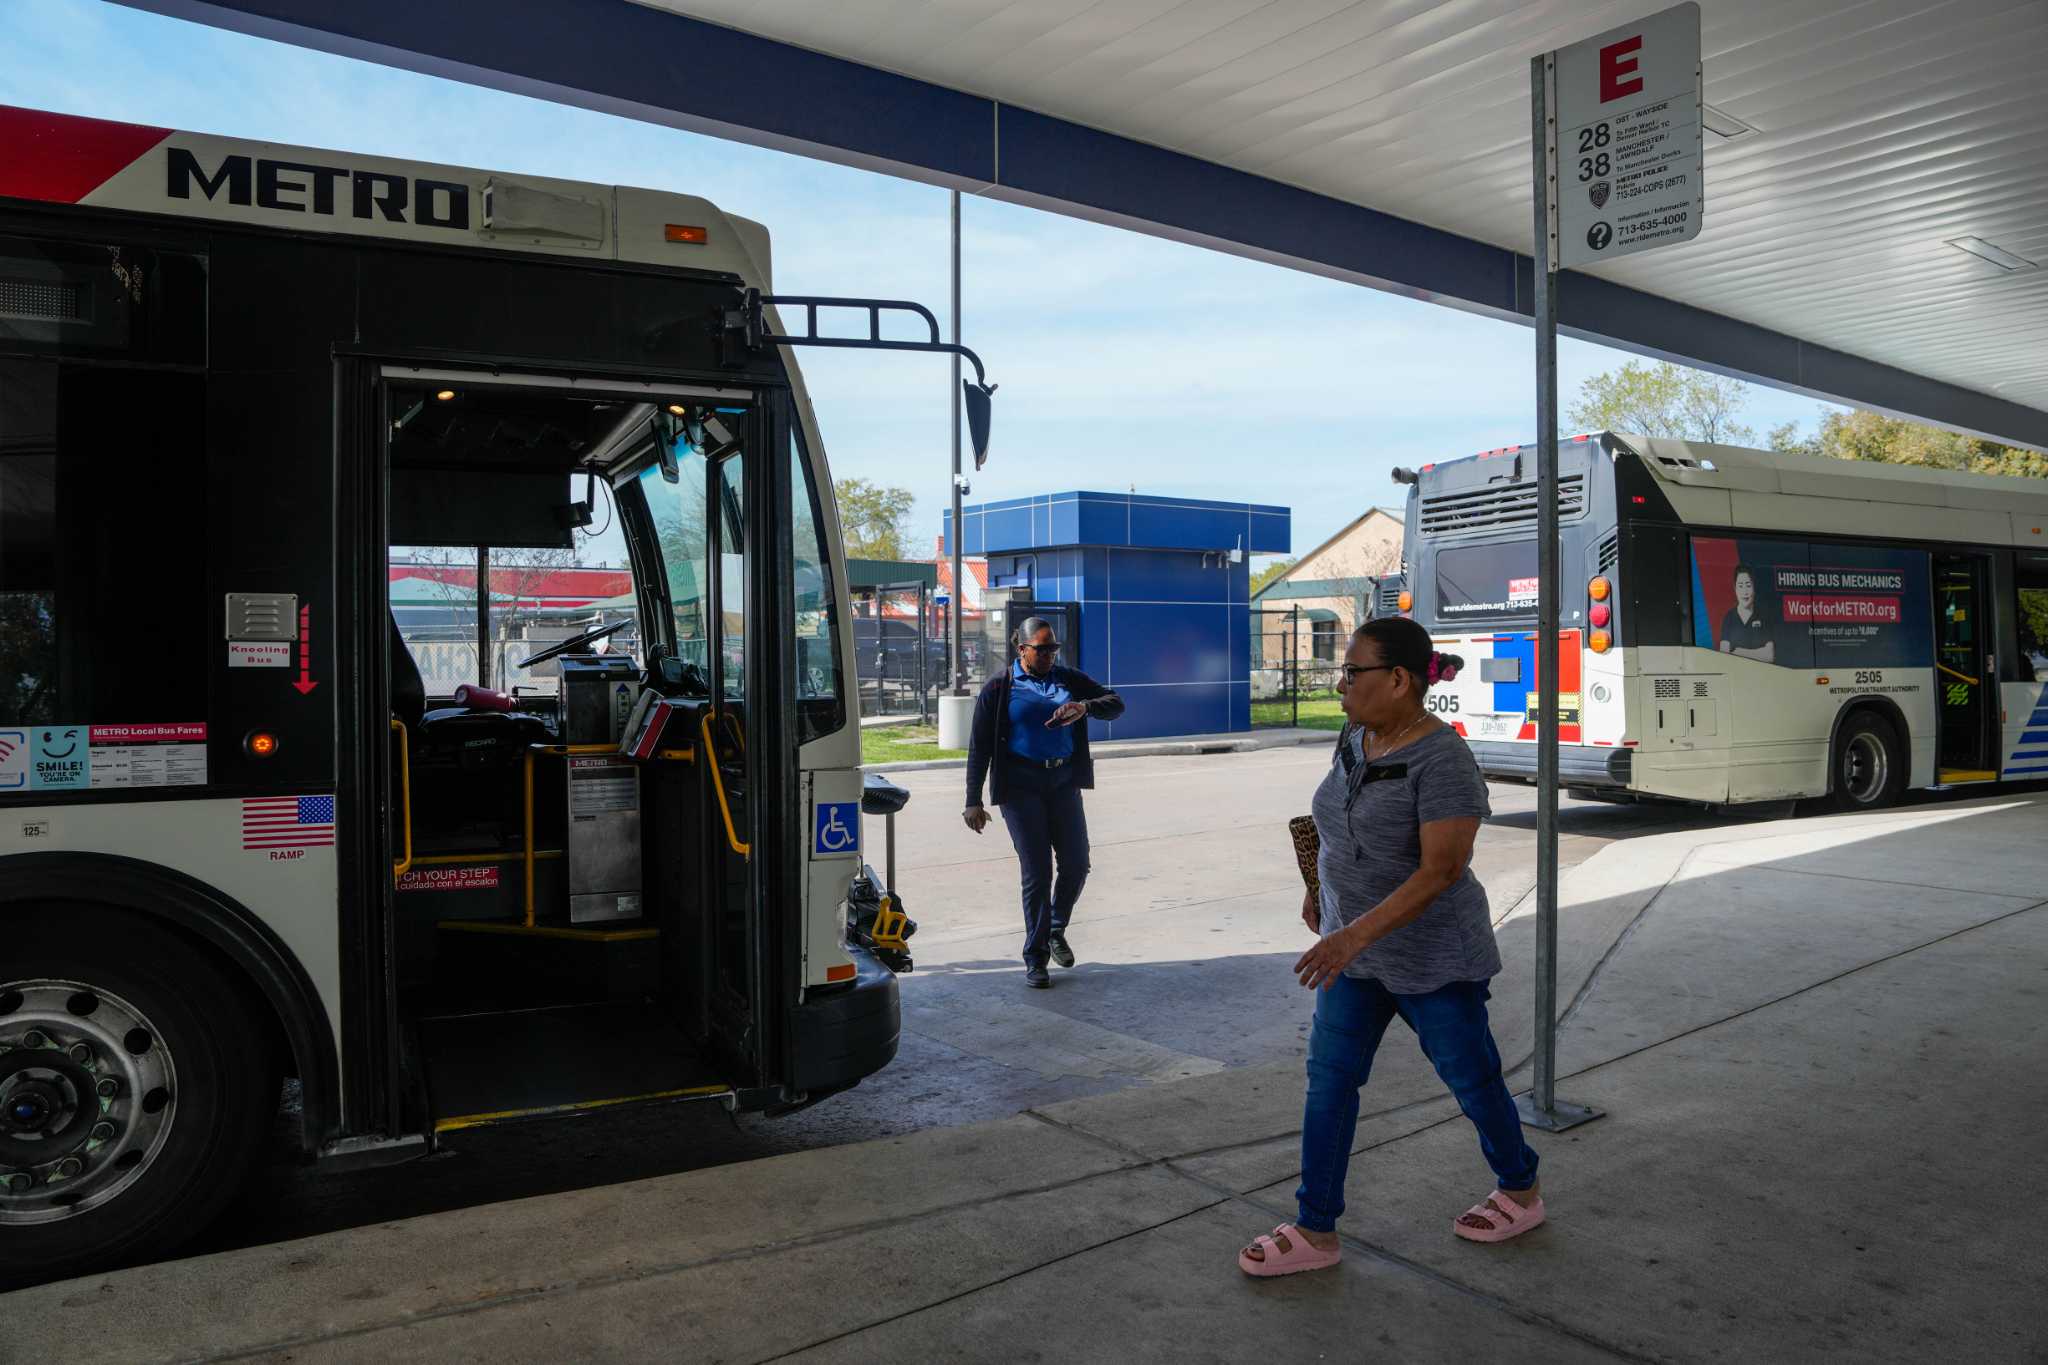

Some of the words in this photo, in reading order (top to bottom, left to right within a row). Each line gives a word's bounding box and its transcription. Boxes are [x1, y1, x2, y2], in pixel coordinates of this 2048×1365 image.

[1600, 34, 1643, 104] E
[1635, 103, 1669, 119] WAYSIDE
[1579, 123, 1611, 154] 28
[1616, 134, 1665, 154] MANCHESTER
[1616, 145, 1655, 162] LAWNDALE
[1579, 153, 1611, 182] 38
[168, 147, 469, 230] METRO
[1618, 212, 1688, 236] 713-635-4000
[1618, 226, 1684, 246] www.ridemetro.org
[1778, 572, 1816, 586] HIRING
[1818, 574, 1840, 587] BUS
[1841, 575, 1902, 589] MECHANICS
[1443, 602, 1505, 612] www.ridemetro.org
[1787, 600, 1897, 620] WorkforMETRO.org
[247, 656, 273, 664] Bus
[1855, 671, 1882, 684] 2505
[1829, 686, 1870, 695] METROPOLITAN
[1892, 685, 1921, 693] AUTHORITY
[1424, 694, 1460, 713] 505
[93, 728, 129, 736] METRO
[131, 727, 156, 735] Local
[157, 727, 176, 735] Bus
[177, 726, 203, 735] Fares
[36, 761, 83, 772] SMILE!
[575, 759, 608, 767] METRO
[40, 771, 67, 779] YOU'RE
[68, 770, 80, 778] ON
[24, 826, 40, 836] 125
[270, 850, 304, 861] RAMP
[424, 870, 456, 881] YOUR
[460, 868, 490, 880] STEP
[401, 880, 435, 890] cuidado
[437, 880, 453, 889] con
[455, 878, 463, 887] el
